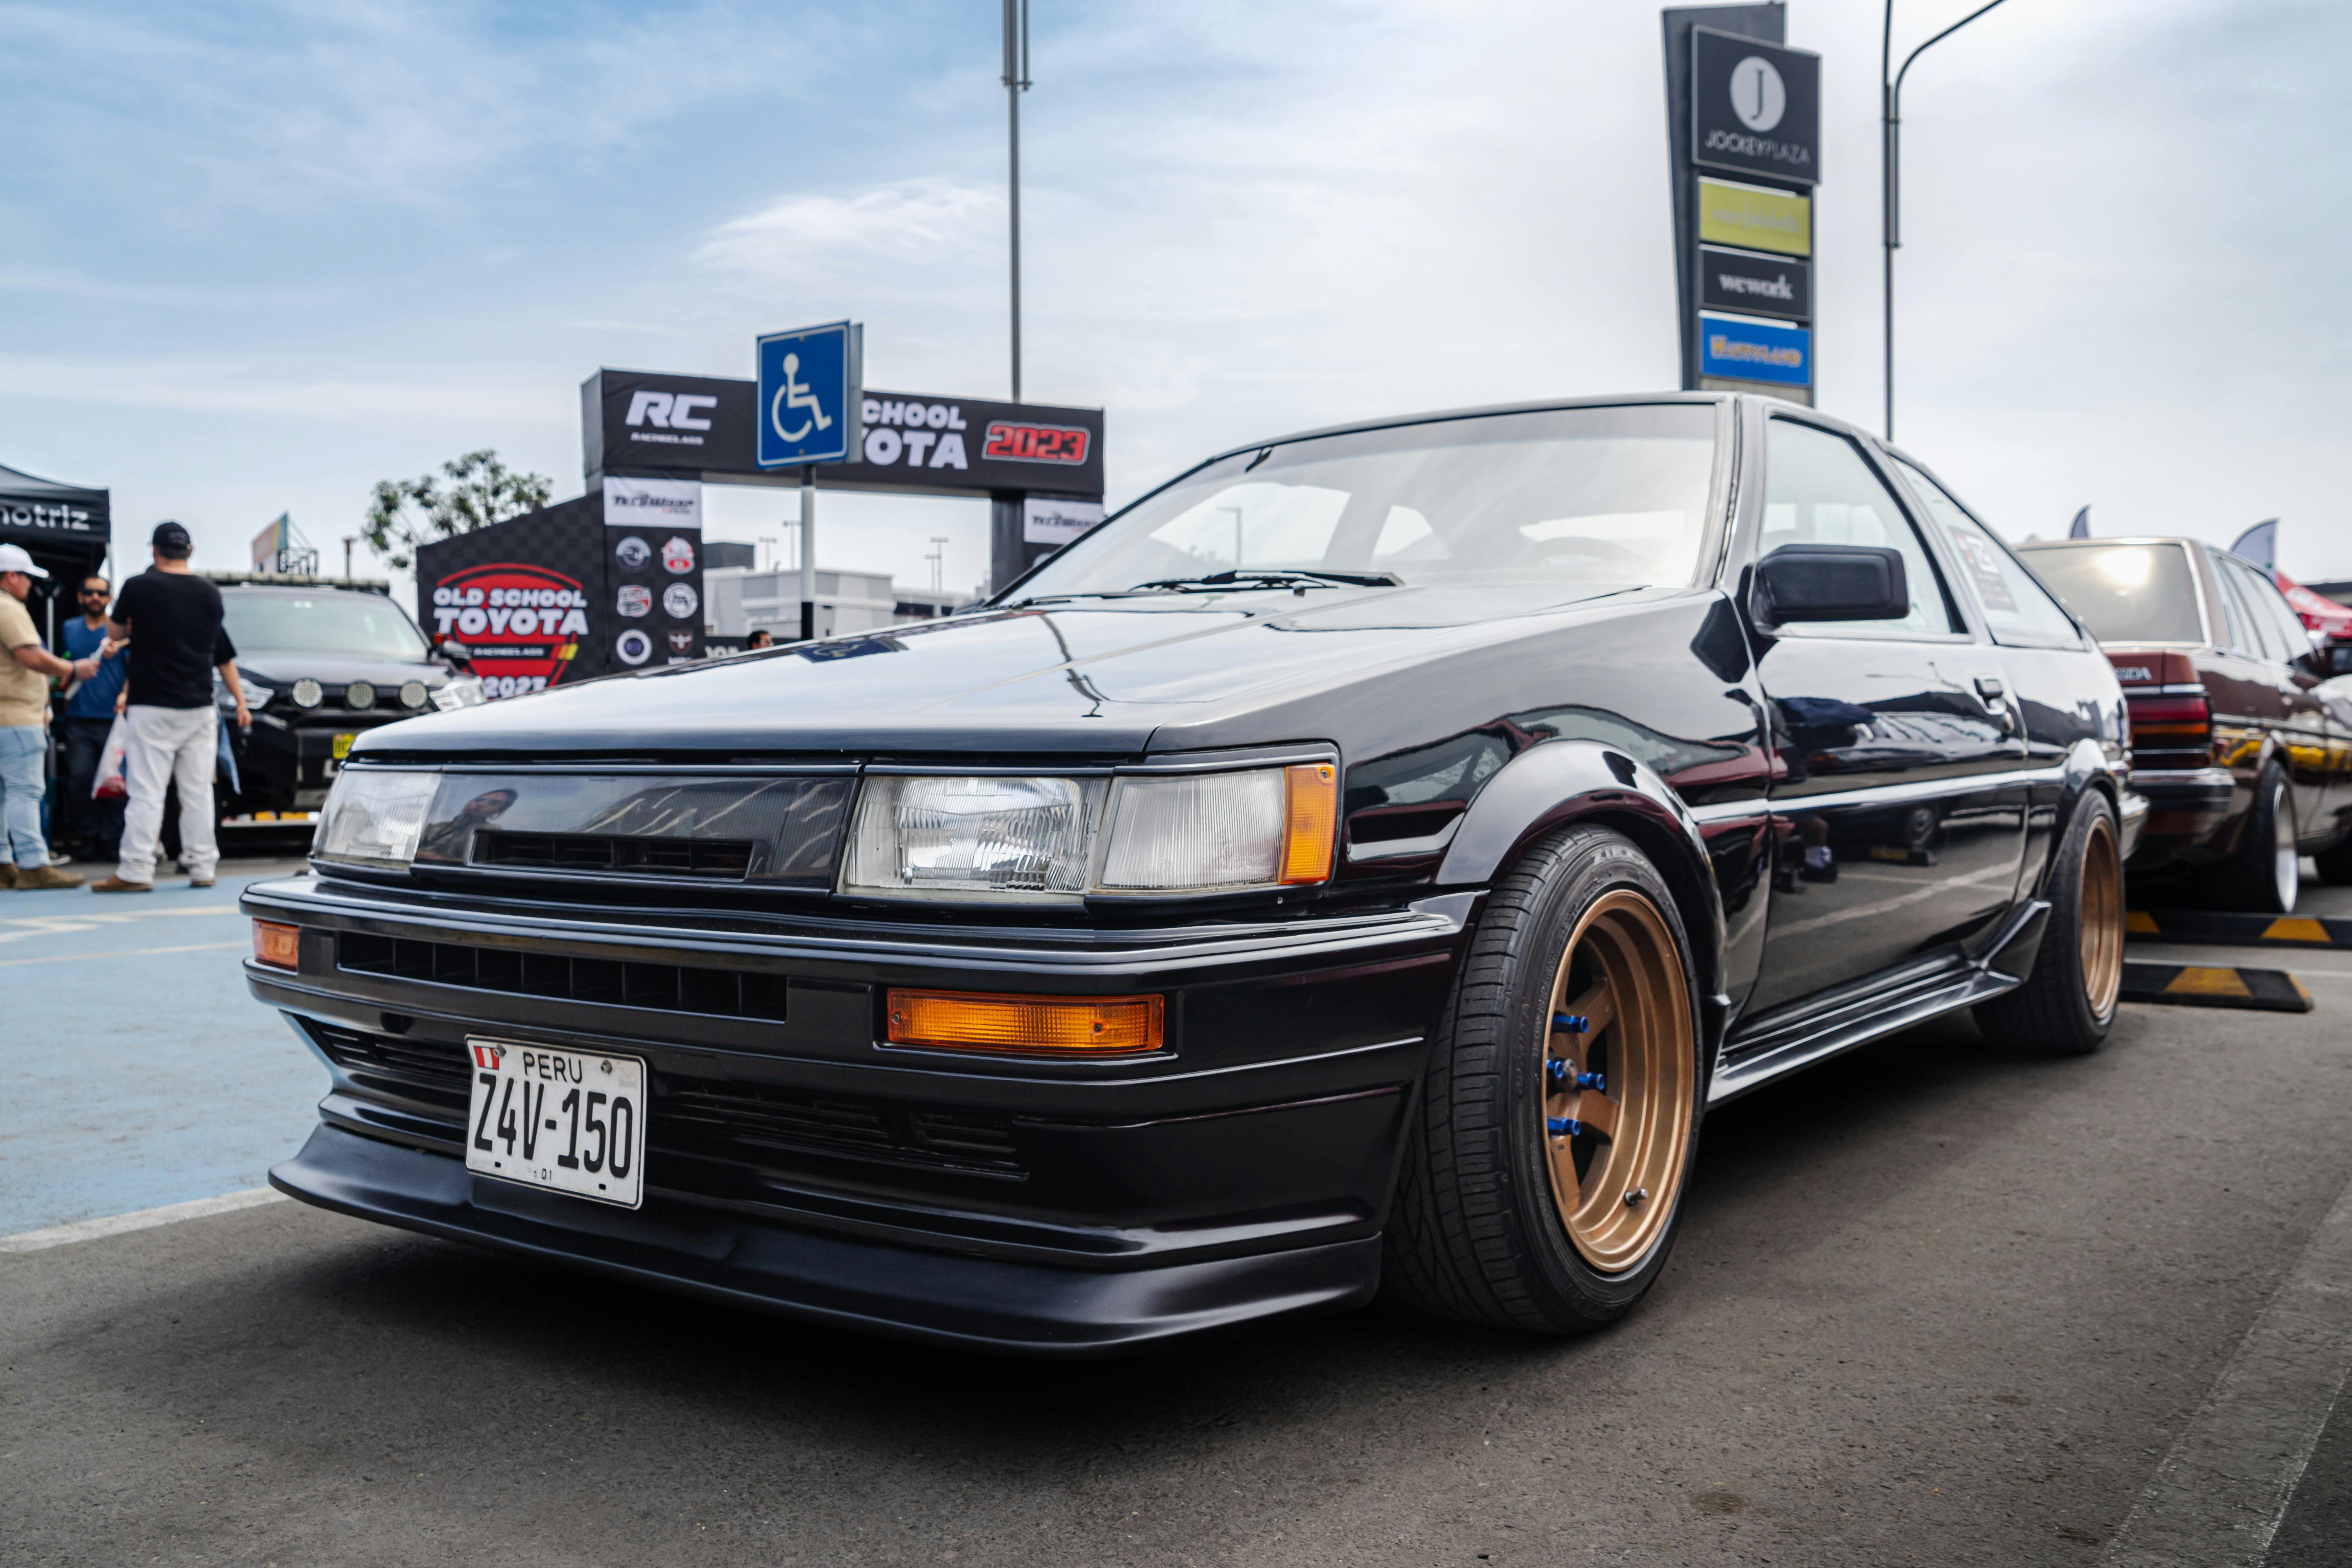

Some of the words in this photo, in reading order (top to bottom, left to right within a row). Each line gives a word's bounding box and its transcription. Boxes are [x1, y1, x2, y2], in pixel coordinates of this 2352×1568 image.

[1718, 274, 1794, 300] wework
[626, 390, 718, 430] RC
[862, 398, 967, 430] CHOOL
[861, 427, 968, 470] OTA
[983, 423, 1090, 463] 2023
[433, 587, 485, 607] OLD
[488, 588, 587, 608] SCHOOL
[433, 608, 588, 635] TOYOTA
[523, 1051, 583, 1084] PERU
[474, 1072, 633, 1179] Z4V-150
